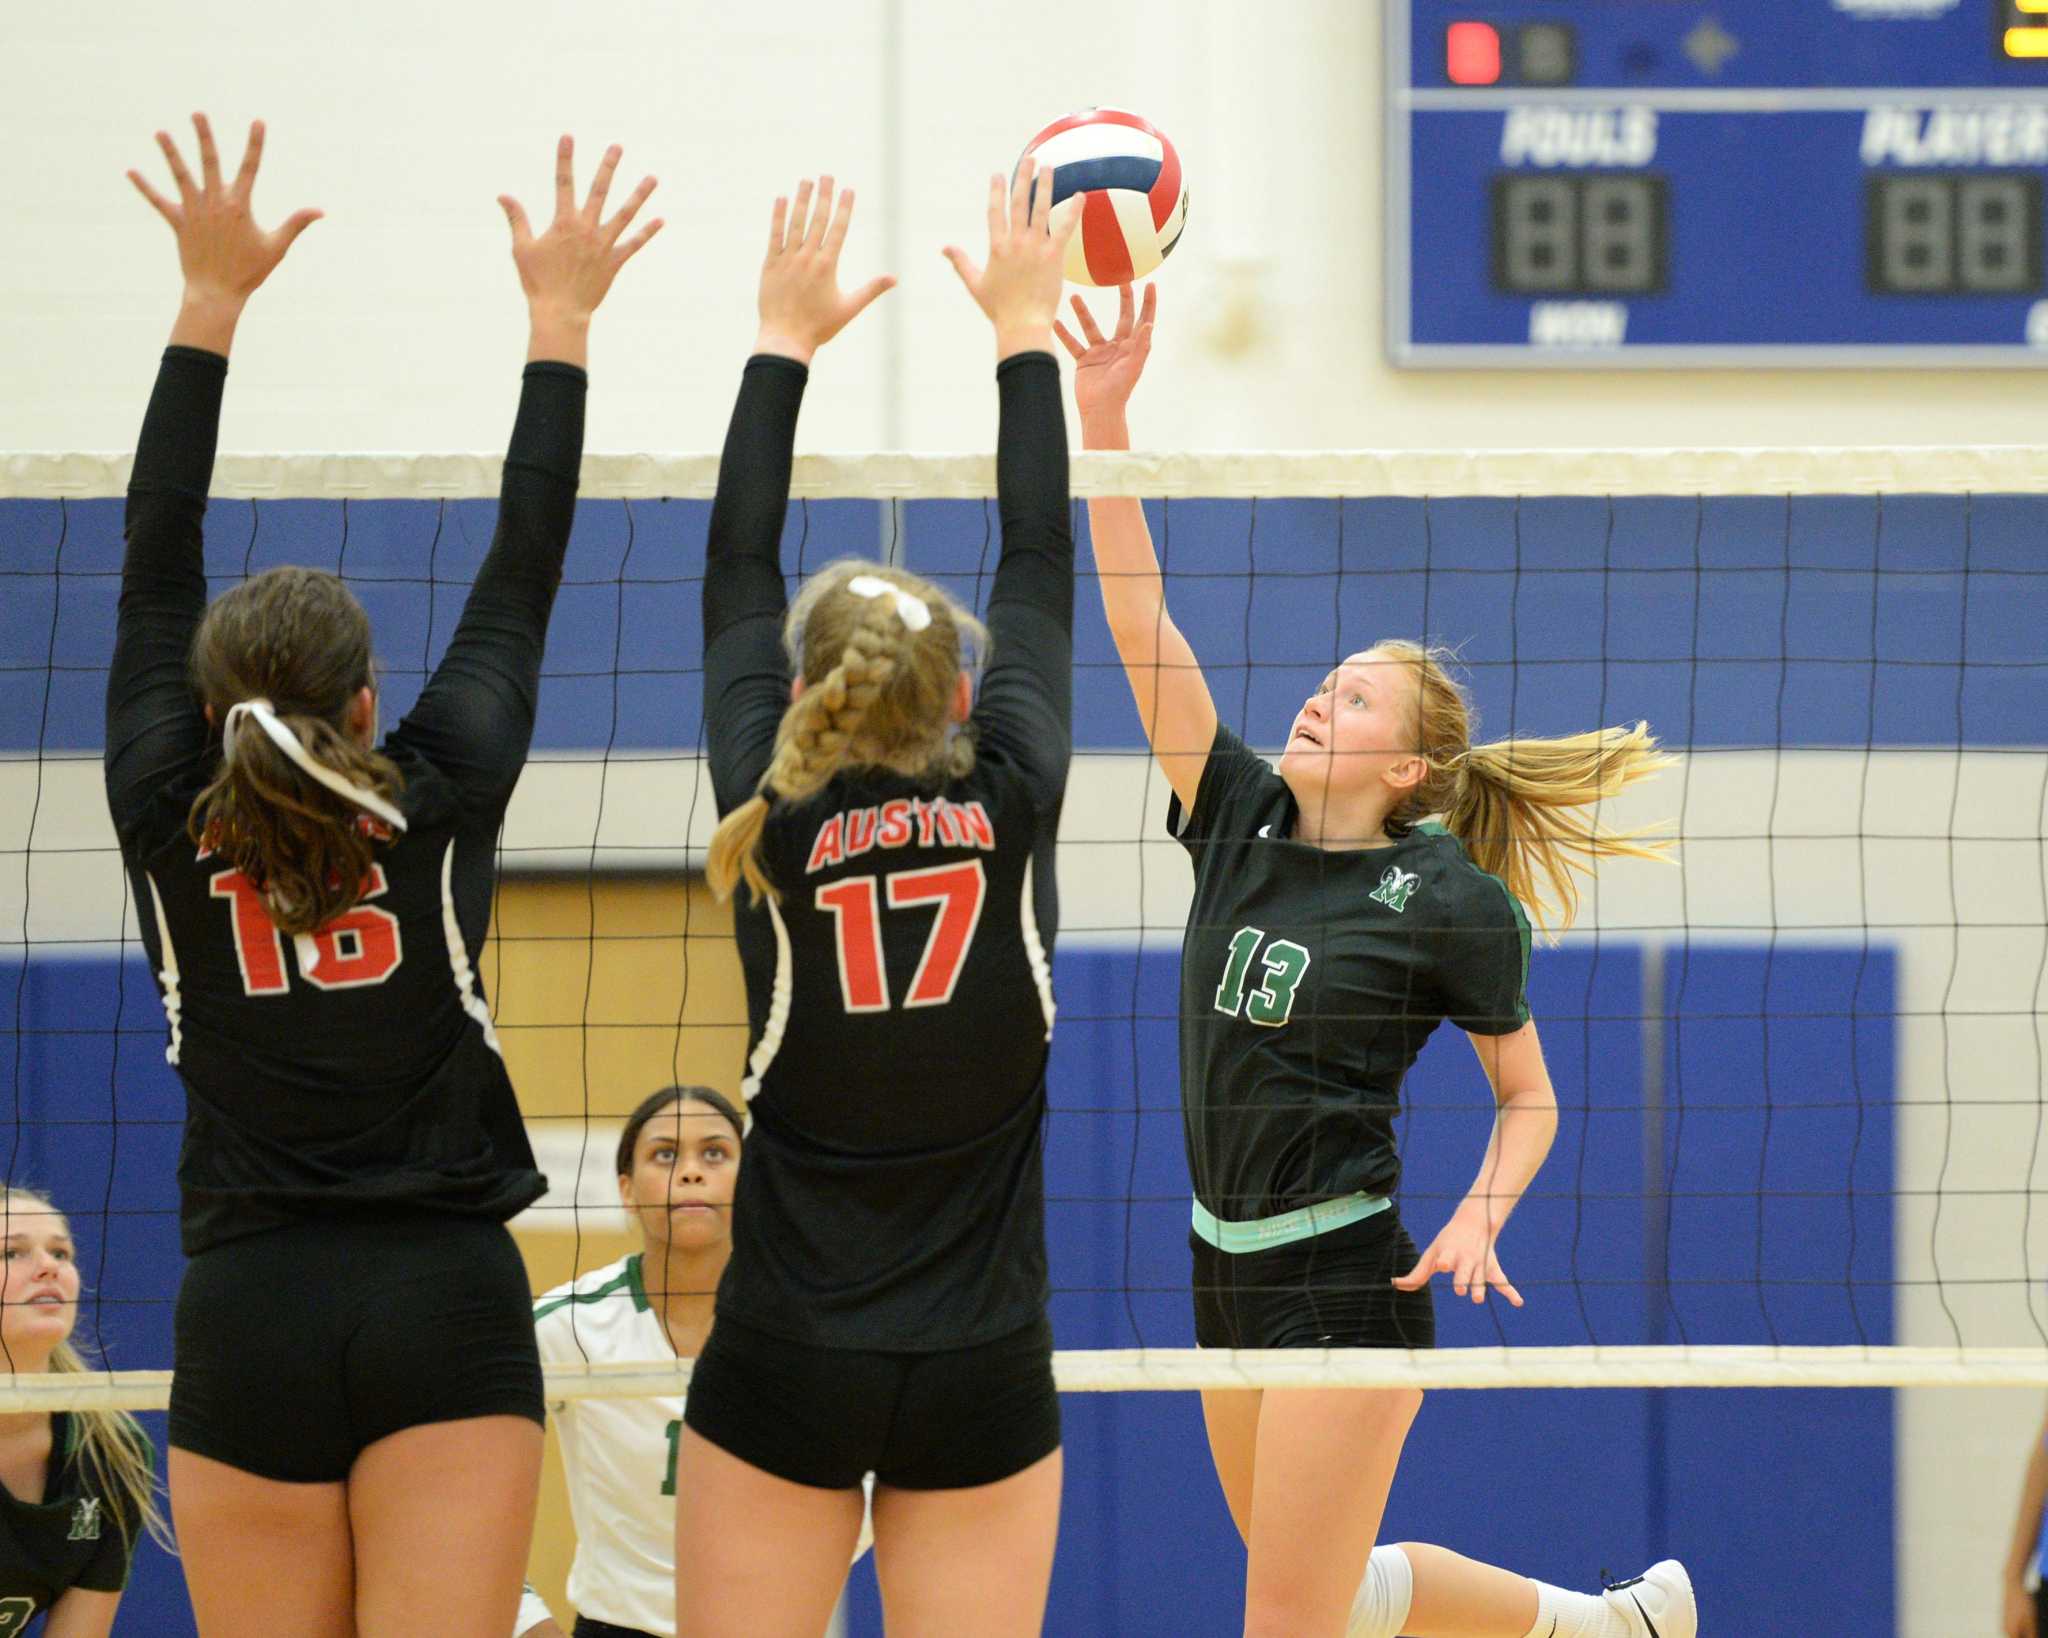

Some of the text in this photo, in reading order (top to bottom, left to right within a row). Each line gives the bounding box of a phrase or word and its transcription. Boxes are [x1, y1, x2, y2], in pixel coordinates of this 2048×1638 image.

[804, 796, 996, 876] AUSTIN
[210, 862, 403, 996] 16
[815, 857, 987, 1014] 17
[1214, 926, 1311, 1028] 13
